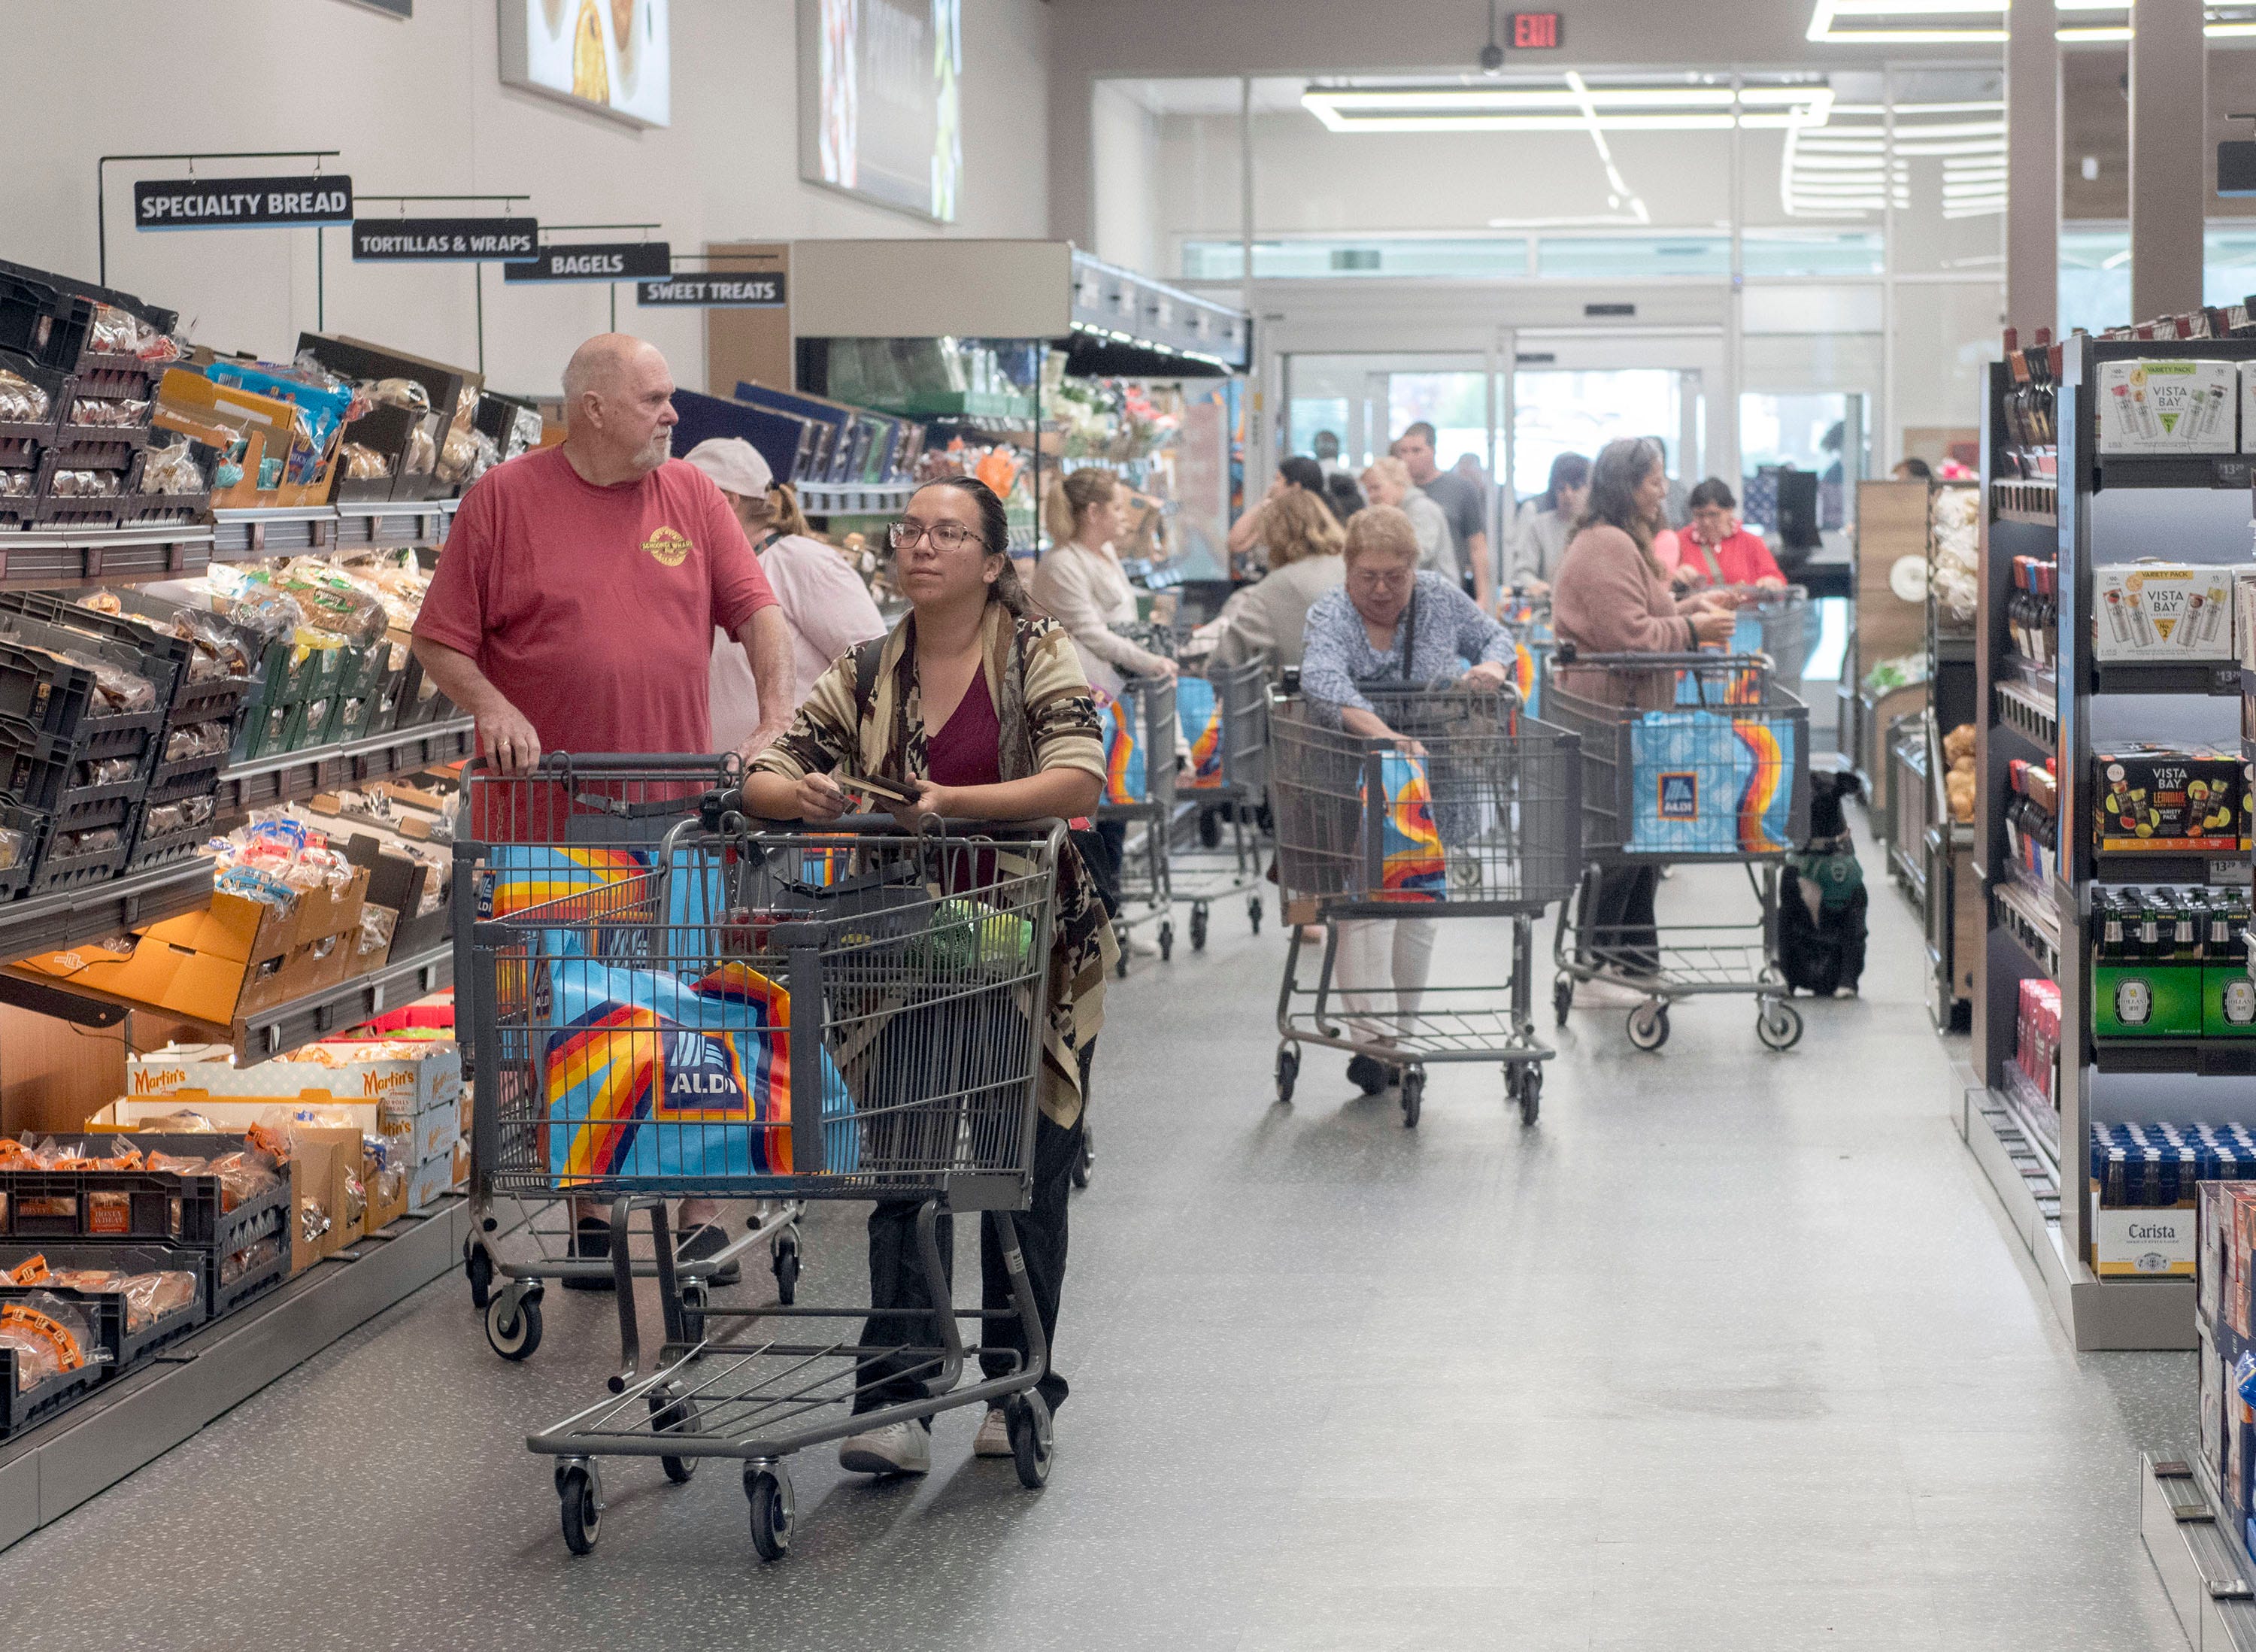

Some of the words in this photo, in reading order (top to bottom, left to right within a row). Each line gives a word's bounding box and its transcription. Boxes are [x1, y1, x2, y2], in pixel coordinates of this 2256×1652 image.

[1515, 14, 1556, 47] EXIT
[142, 193, 262, 218] SPECIALTY
[268, 191, 347, 214] BREAD
[360, 235, 450, 253] TORTILLAS
[453, 235, 466, 252] &
[470, 235, 531, 252] WRAPS
[551, 254, 624, 274] BAGELS
[647, 281, 706, 300] SWEET
[708, 281, 776, 300] TREATS
[2153, 386, 2187, 396] VISTA
[2159, 397, 2181, 407] BAY
[2148, 591, 2184, 601] VISTA
[2154, 602, 2178, 612] BAY
[2163, 629, 2168, 638] 2
[2153, 768, 2188, 779] VISTA
[2158, 779, 2181, 789] BAY
[134, 1068, 186, 1094] Martin's
[362, 1070, 414, 1096] Martin's
[671, 1073, 737, 1093] ALDI
[2128, 1223, 2176, 1238] Carista
